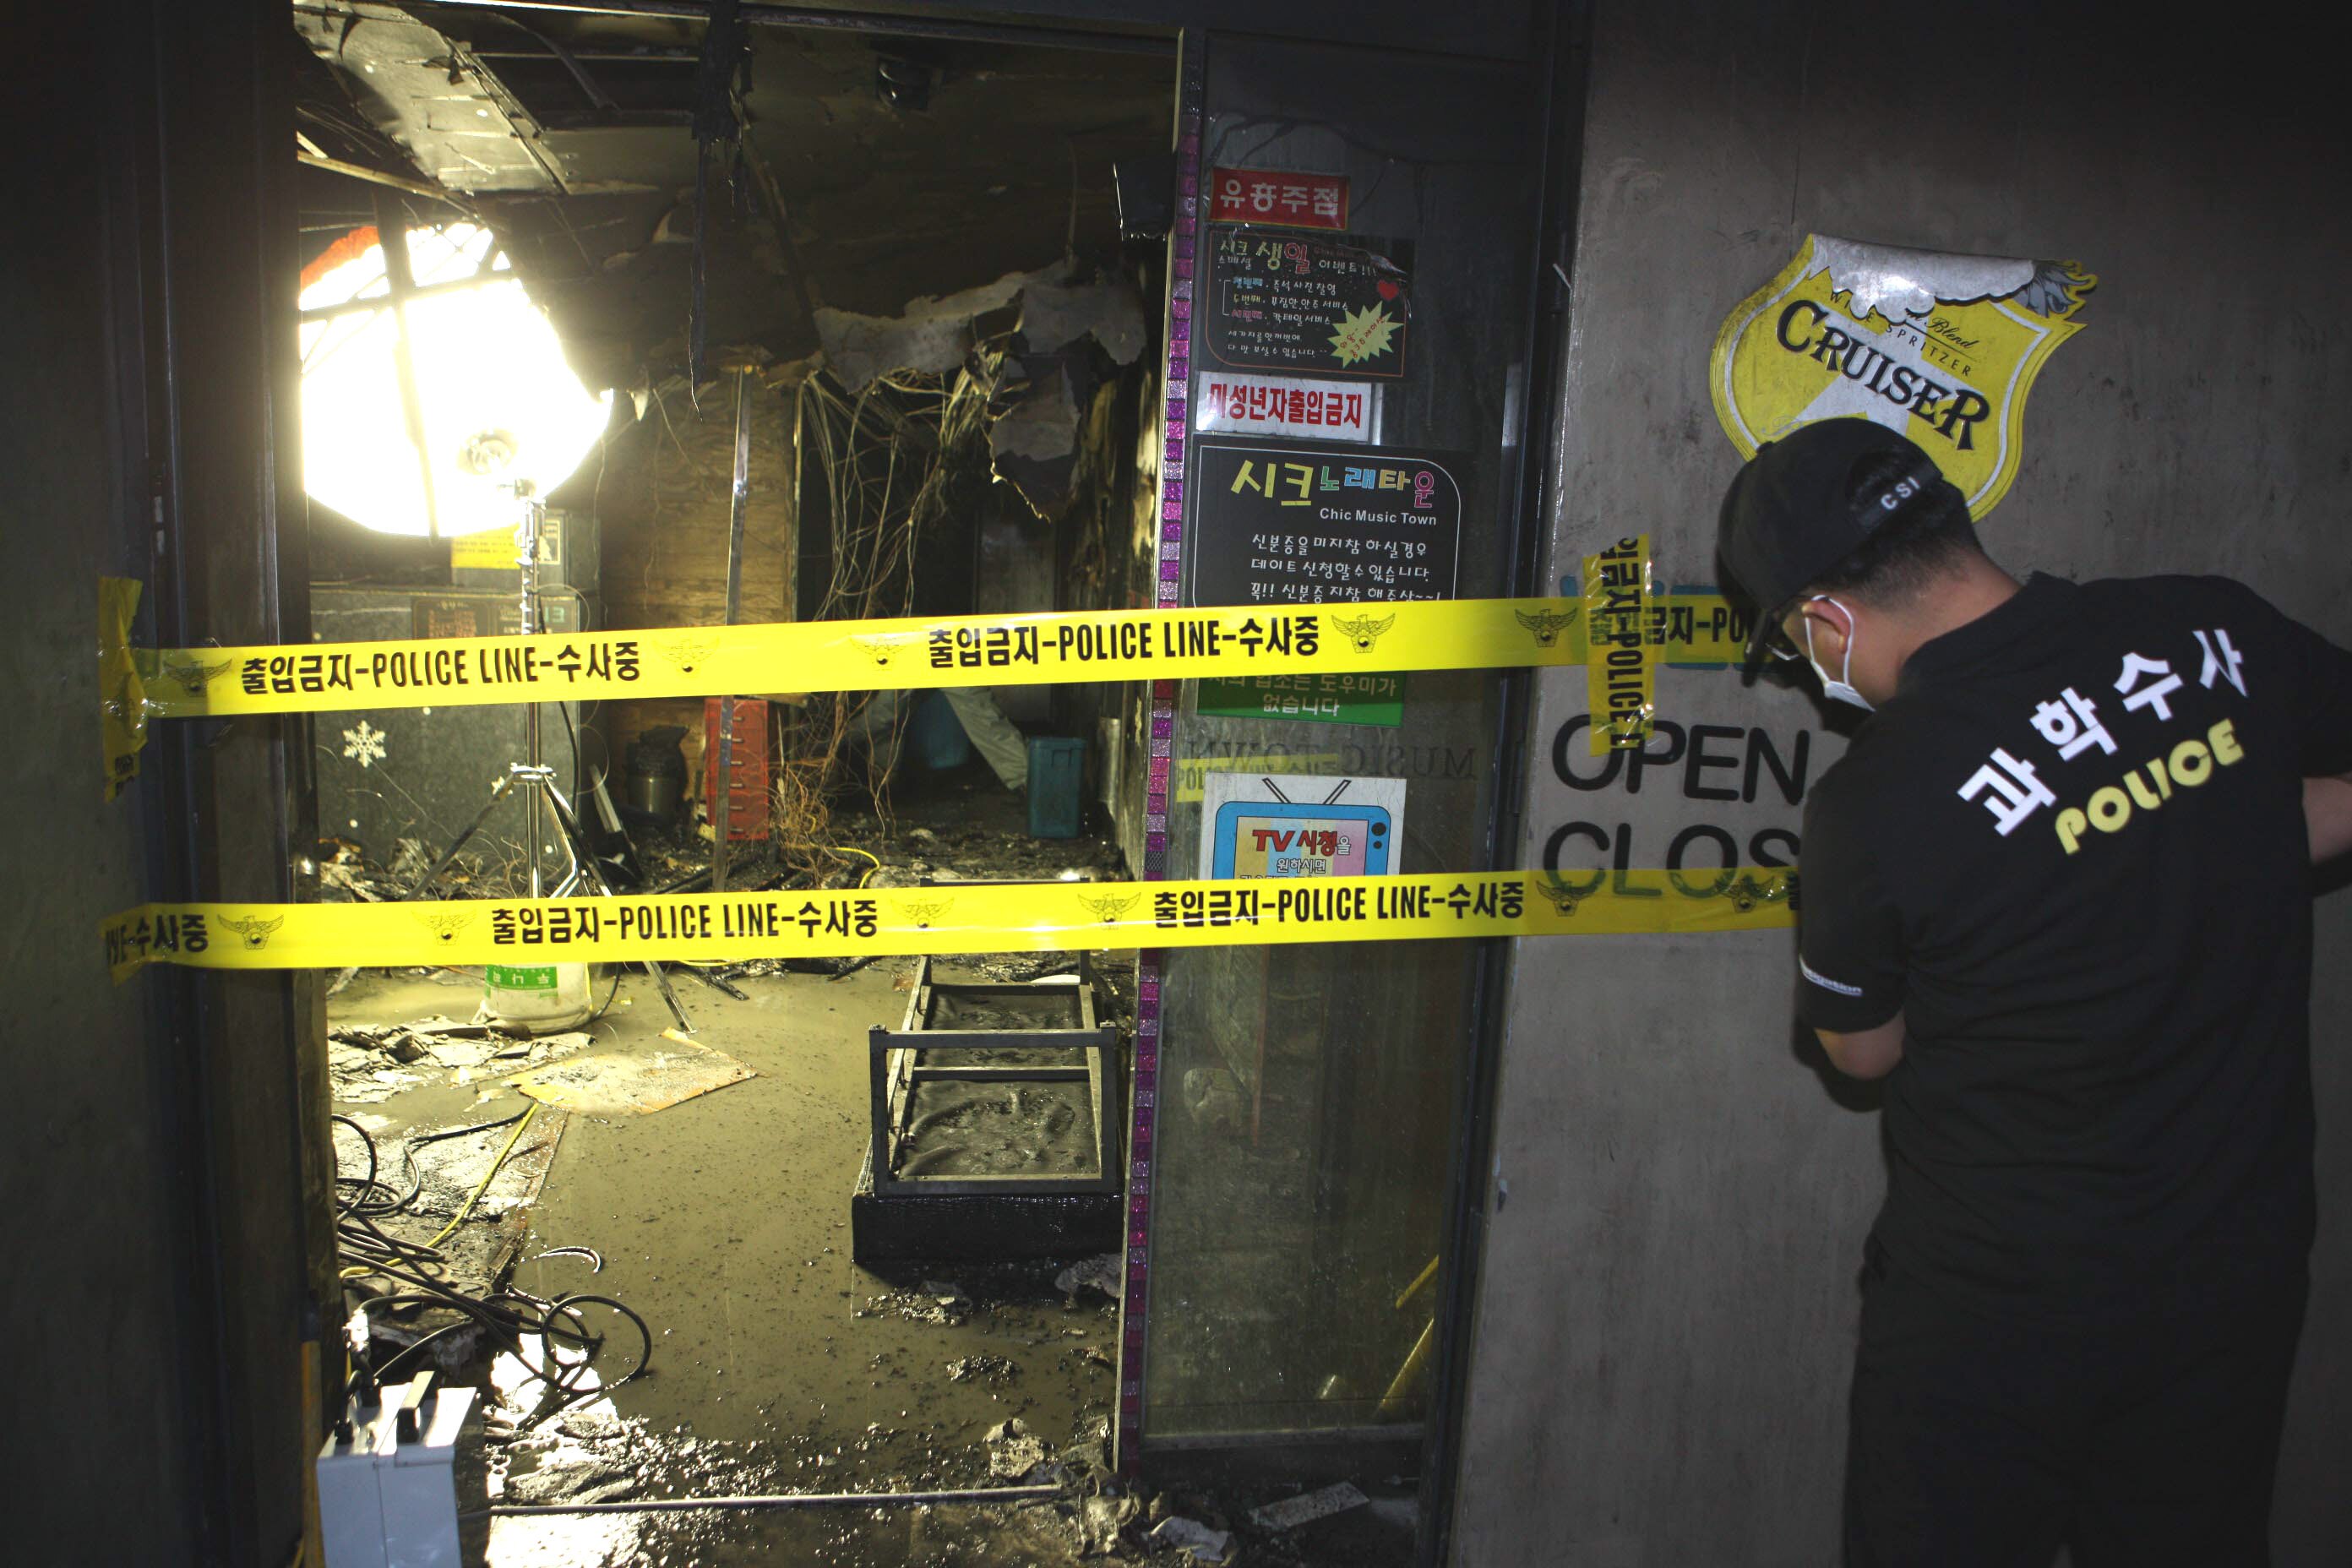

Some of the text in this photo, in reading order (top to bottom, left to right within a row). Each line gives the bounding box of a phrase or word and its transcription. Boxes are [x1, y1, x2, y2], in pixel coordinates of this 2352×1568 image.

[1220, 178, 1340, 216] 유흥주점
[1255, 241, 1311, 275] 생일
[1829, 291, 1876, 324] WIE
[1885, 323, 1972, 377] SPRITZER
[1925, 316, 1979, 350] Blend
[1776, 299, 1990, 451] CRUISER
[1209, 383, 1363, 428] 미성년자출입금지
[1880, 476, 1921, 510] CSI
[1320, 508, 1437, 525] Chic Music Town
[1262, 694, 1341, 717] 없습니다
[1956, 629, 2248, 837] 과학수사
[1552, 714, 1810, 806] OPEN
[2055, 717, 2246, 856] POLICE
[1252, 829, 1353, 857] TV 시청을
[1277, 858, 1327, 874] 원하시면
